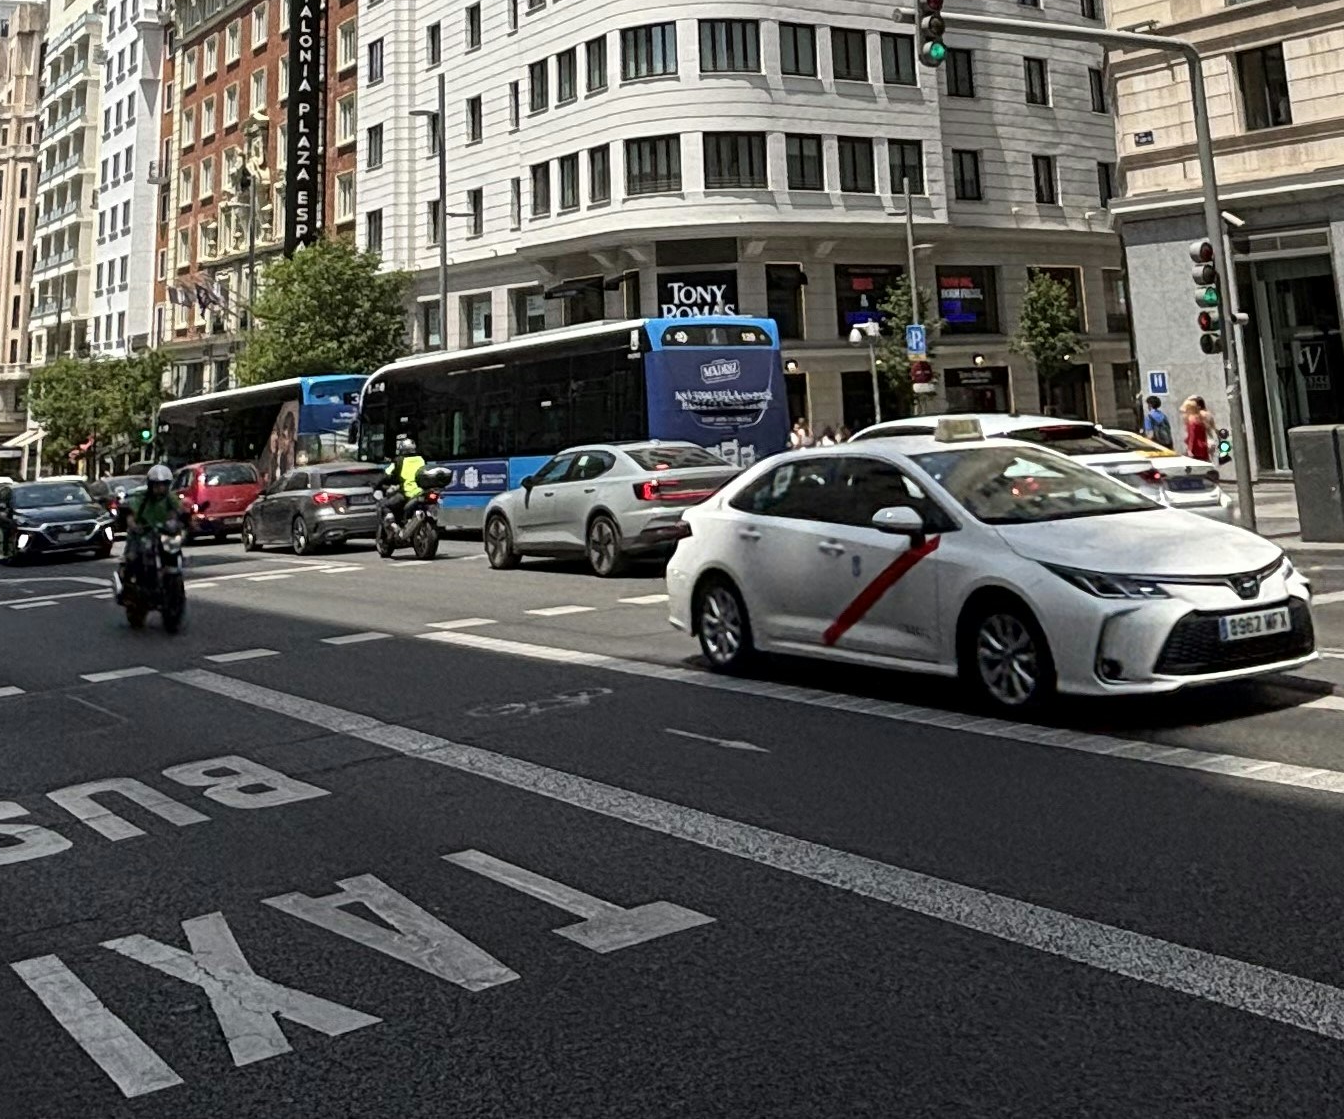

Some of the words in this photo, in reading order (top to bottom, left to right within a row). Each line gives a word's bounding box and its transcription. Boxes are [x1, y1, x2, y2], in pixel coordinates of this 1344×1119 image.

[296, 102, 311, 181] PLAZA
[667, 282, 727, 305] TONY
[9, 848, 718, 1098] TAXI
